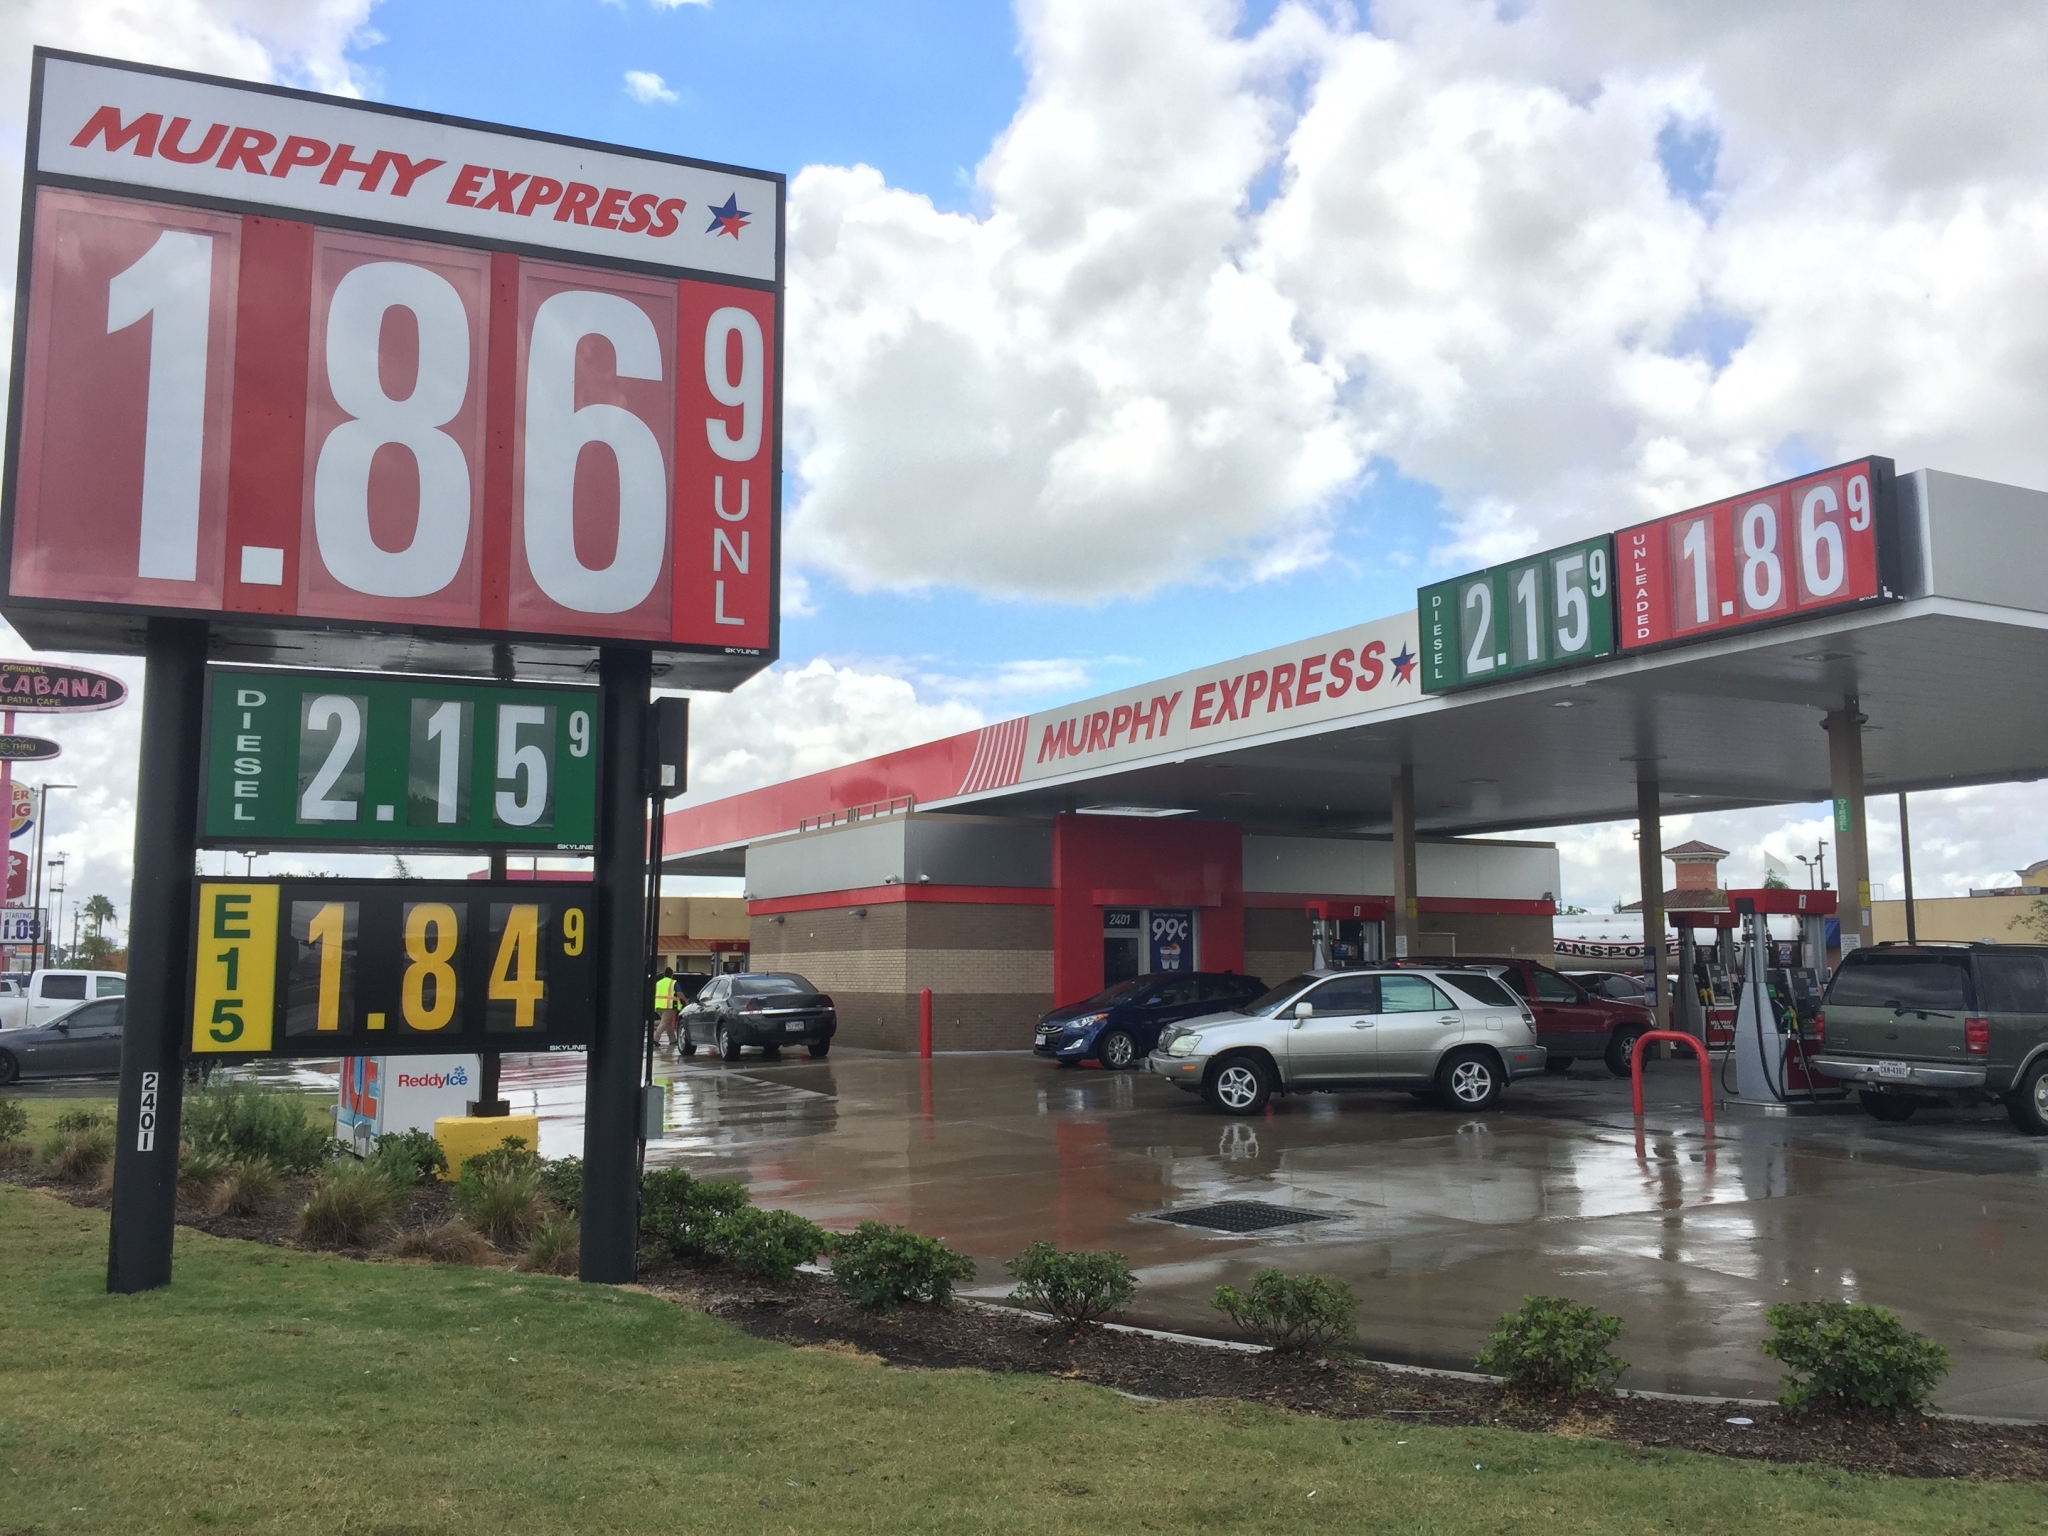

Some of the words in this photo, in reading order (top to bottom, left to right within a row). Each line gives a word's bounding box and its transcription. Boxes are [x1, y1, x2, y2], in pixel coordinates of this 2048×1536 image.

[70, 105, 447, 198] MURPHY
[447, 164, 687, 239] EXPRESS
[714, 477, 750, 626] UNL
[1633, 534, 1650, 640] UNLEADED
[3, 664, 46, 674] ORIGINAL
[725, 647, 760, 655] SKYLINE
[1432, 596, 1443, 680] DIESEL
[0, 674, 107, 700] CABANA
[7, 696, 33, 704] PATIO
[36, 698, 61, 706] CAFE
[1037, 691, 1183, 764] MURPHY
[1190, 640, 1386, 730] EXPRESS
[233, 690, 267, 822] DIESEL
[1109, 914, 1131, 925] 2401
[1152, 918, 1188, 941] 99¢
[209, 894, 252, 1044] E15
[141, 1073, 157, 1150] 2401
[341, 1056, 379, 1120] ICE
